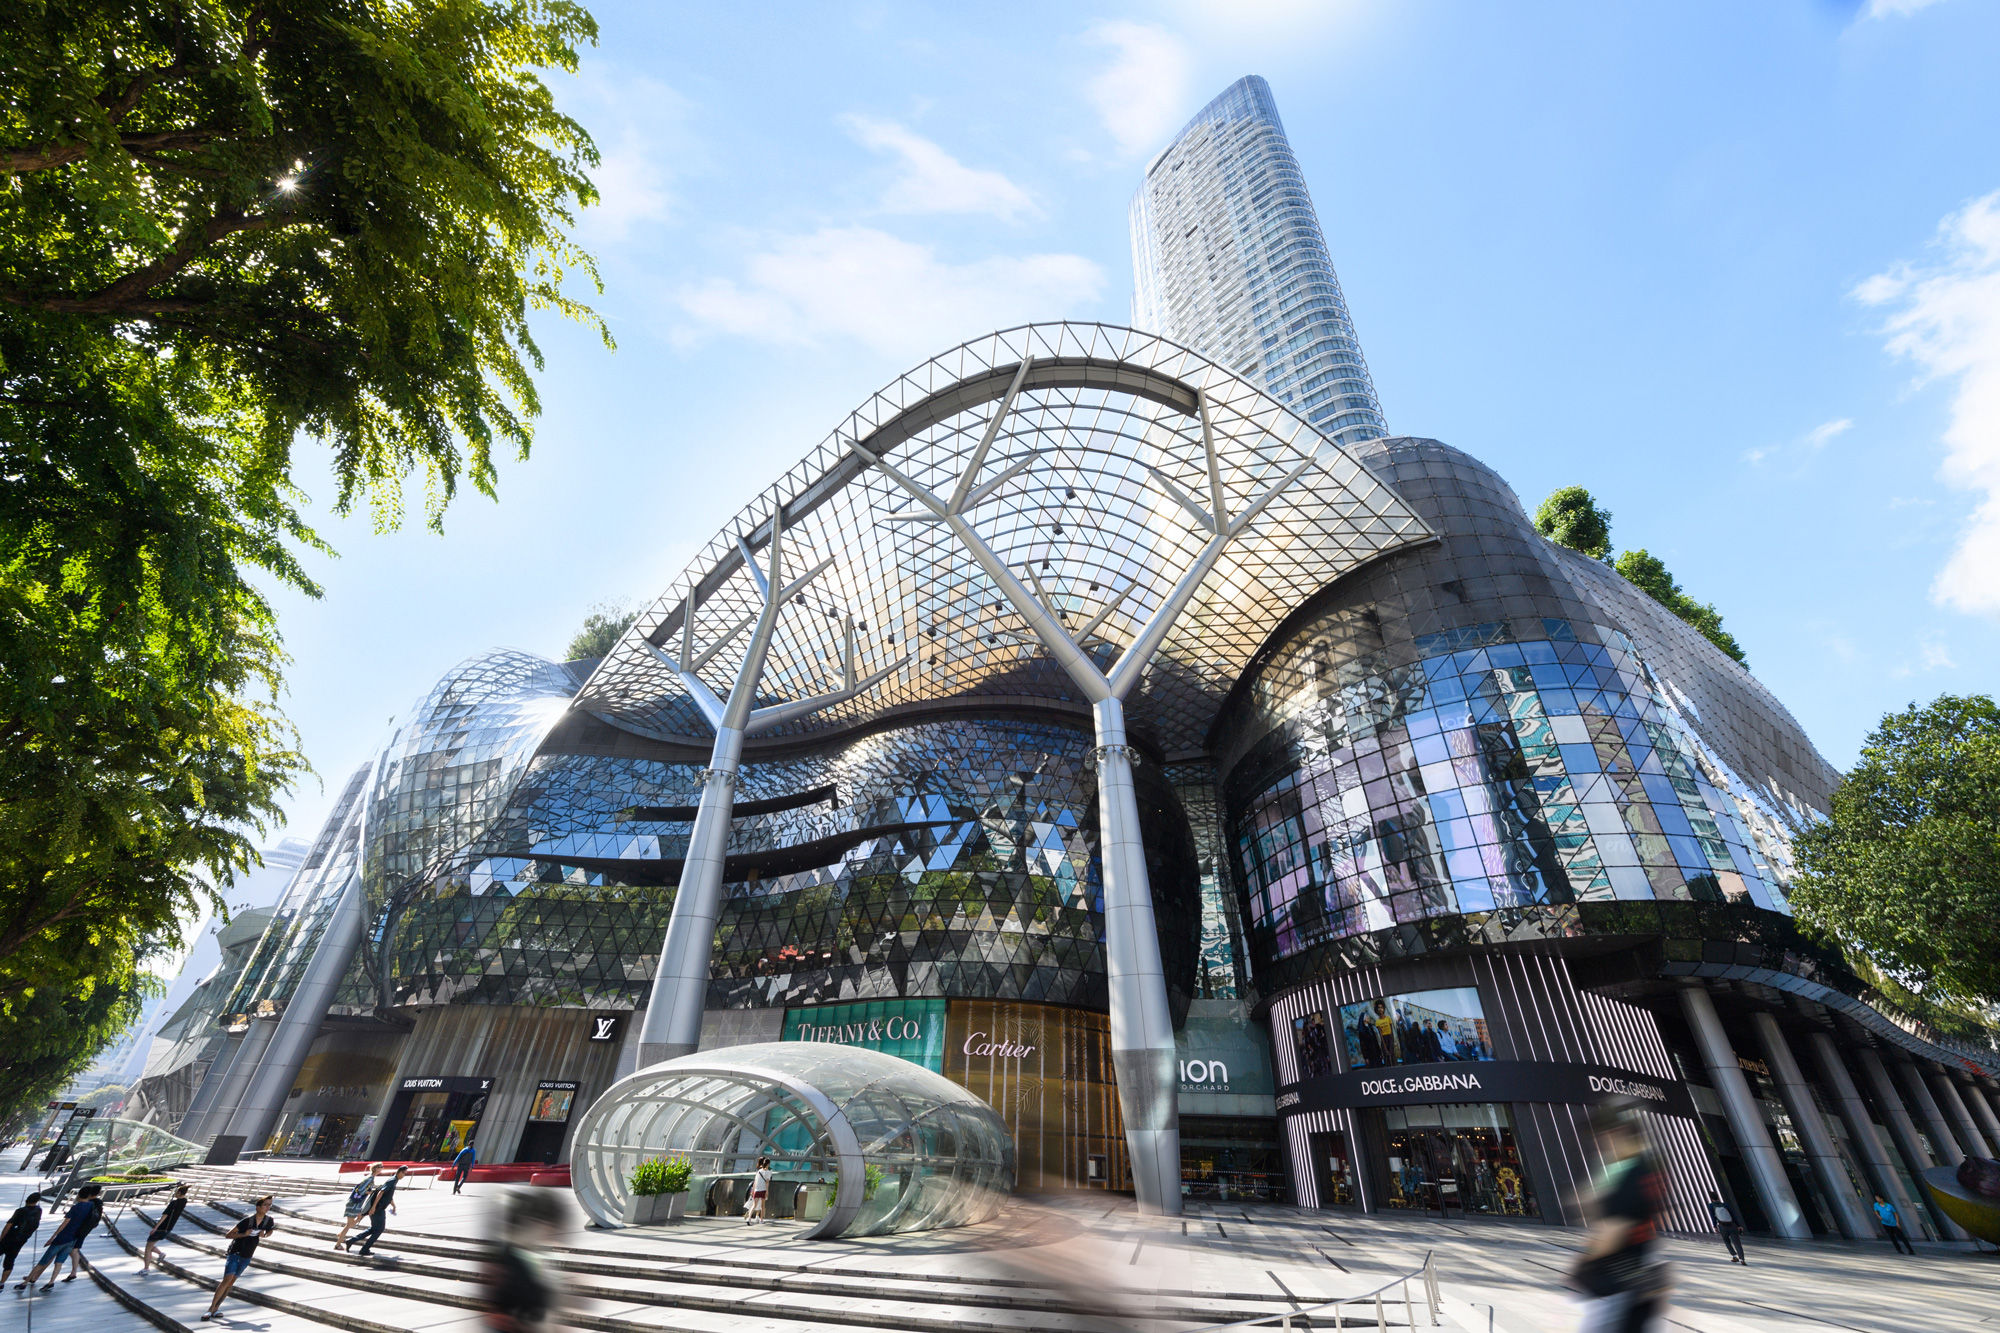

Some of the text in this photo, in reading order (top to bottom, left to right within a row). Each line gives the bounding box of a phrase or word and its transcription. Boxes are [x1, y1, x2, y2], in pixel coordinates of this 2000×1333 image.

[963, 1031, 1036, 1058] Cartier
[403, 1079, 443, 1088] LOUIS VUITTON
[1181, 1083, 1230, 1092] ORCHARD
[1361, 1079, 1397, 1096] DOLCE
[1404, 1073, 1482, 1092] GABBANA
[1588, 1075, 1628, 1094] DOLCE
